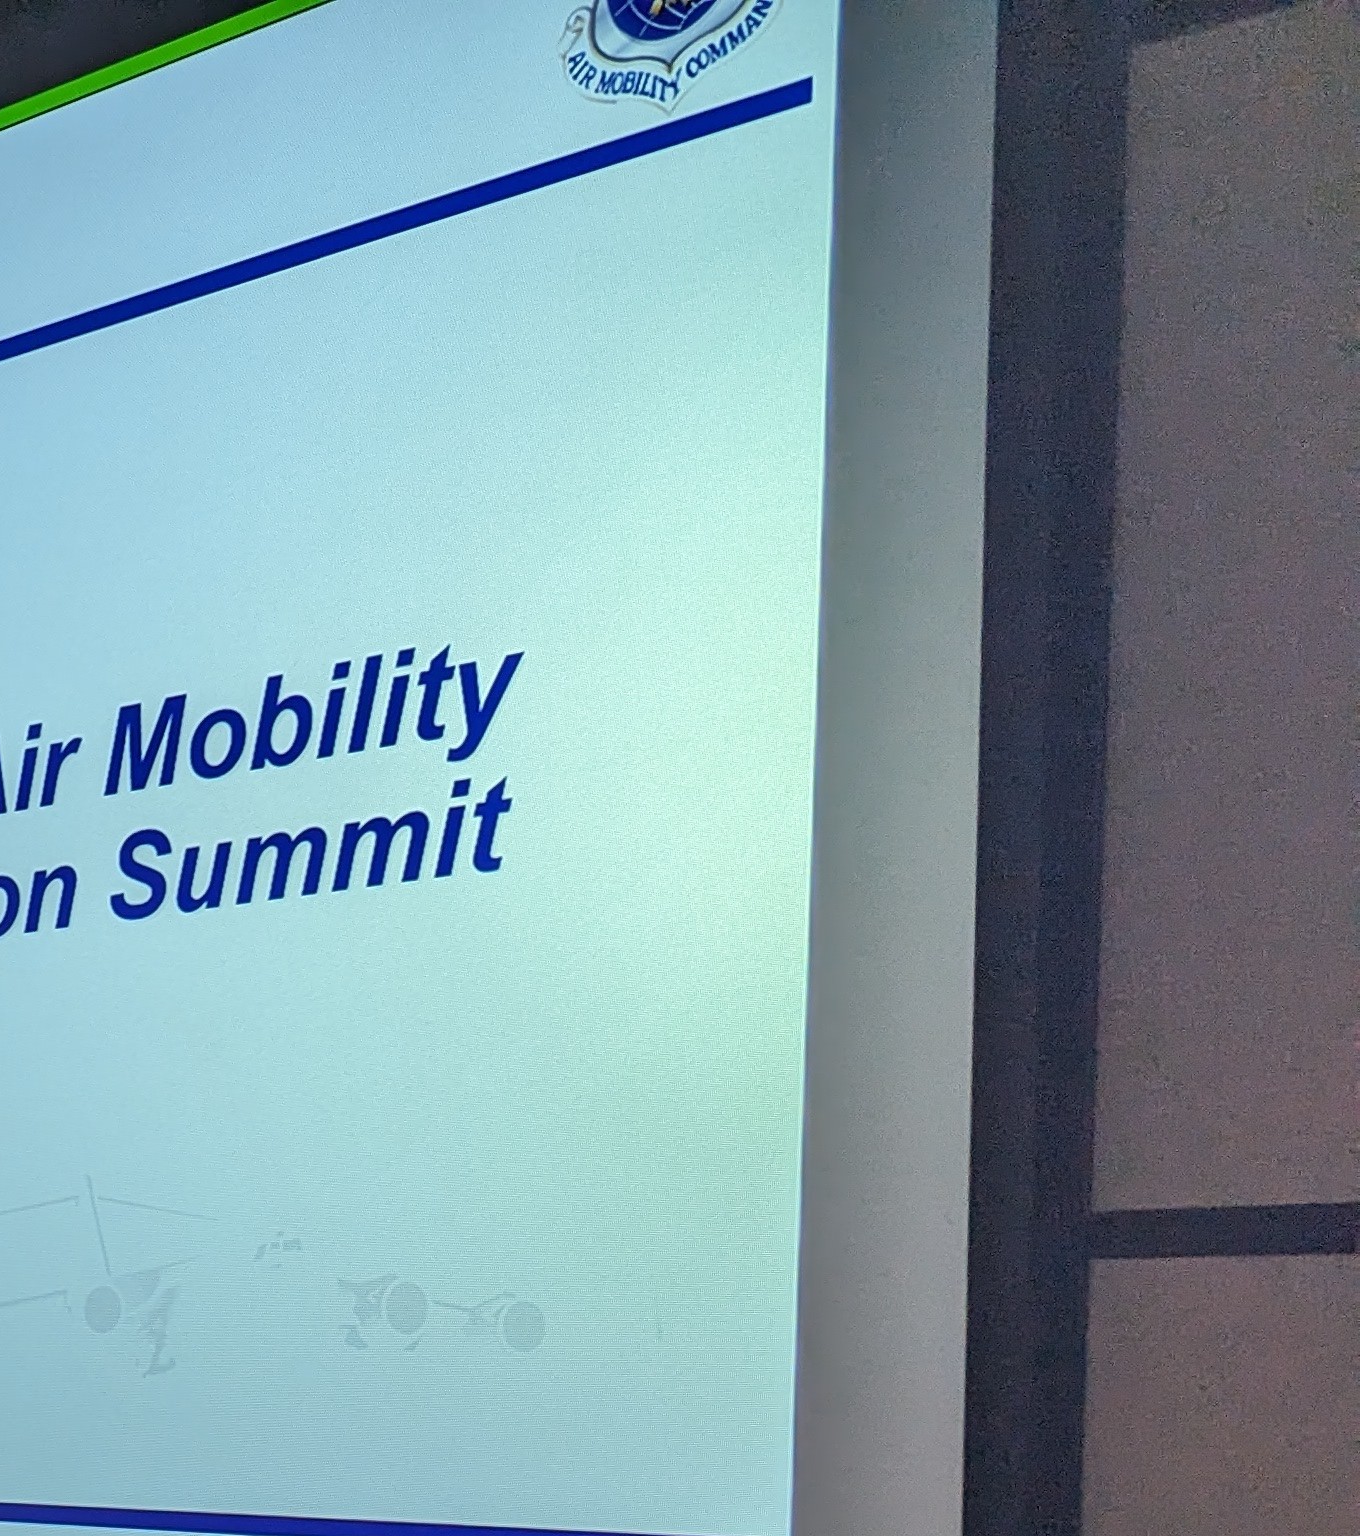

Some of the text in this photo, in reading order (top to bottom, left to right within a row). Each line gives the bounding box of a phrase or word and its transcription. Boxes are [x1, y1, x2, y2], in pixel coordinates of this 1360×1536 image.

[567, 50, 597, 90] AIR
[595, 66, 682, 102] MOBILITY
[103, 644, 525, 797] Mobility
[110, 776, 514, 921] Summit
